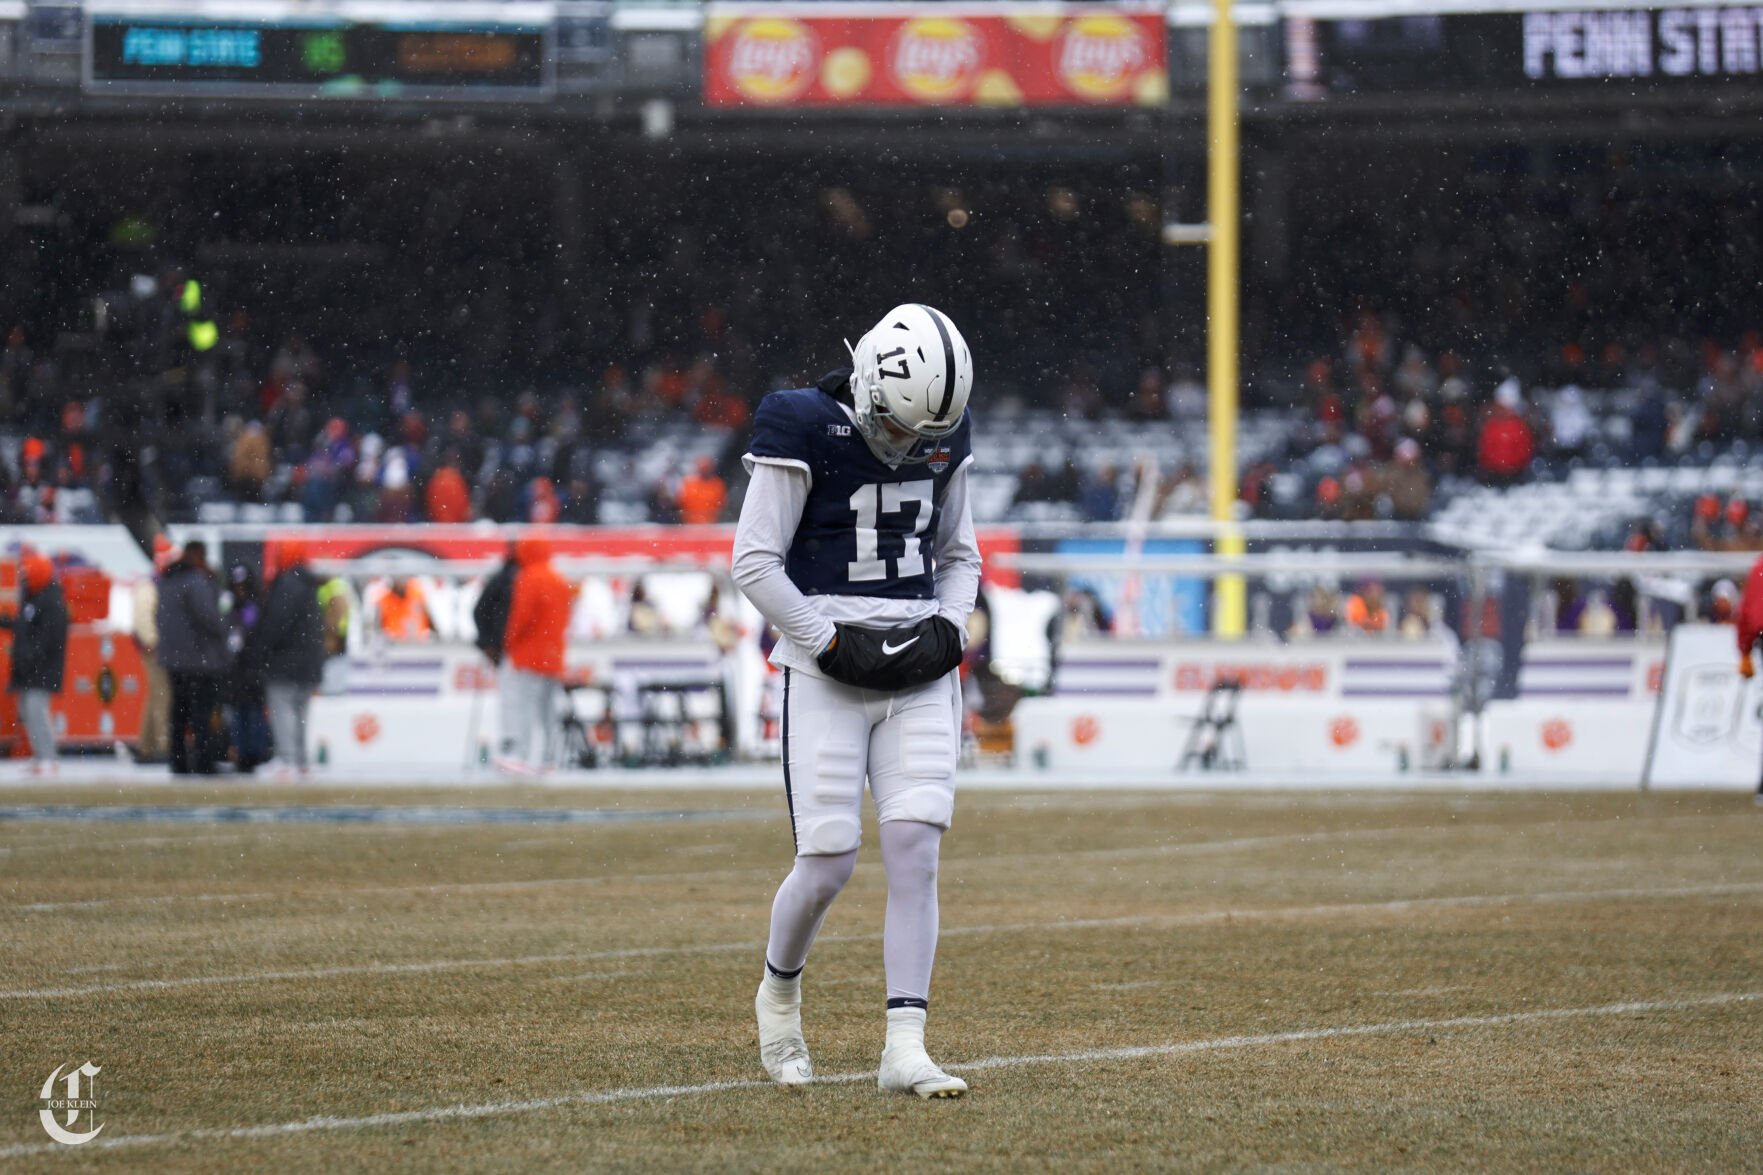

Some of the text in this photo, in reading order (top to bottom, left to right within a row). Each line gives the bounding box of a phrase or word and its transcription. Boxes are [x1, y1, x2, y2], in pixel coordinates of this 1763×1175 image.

[1522, 7, 1763, 78] PENN STA
[876, 346, 911, 380] 17
[848, 480, 934, 582] 17
